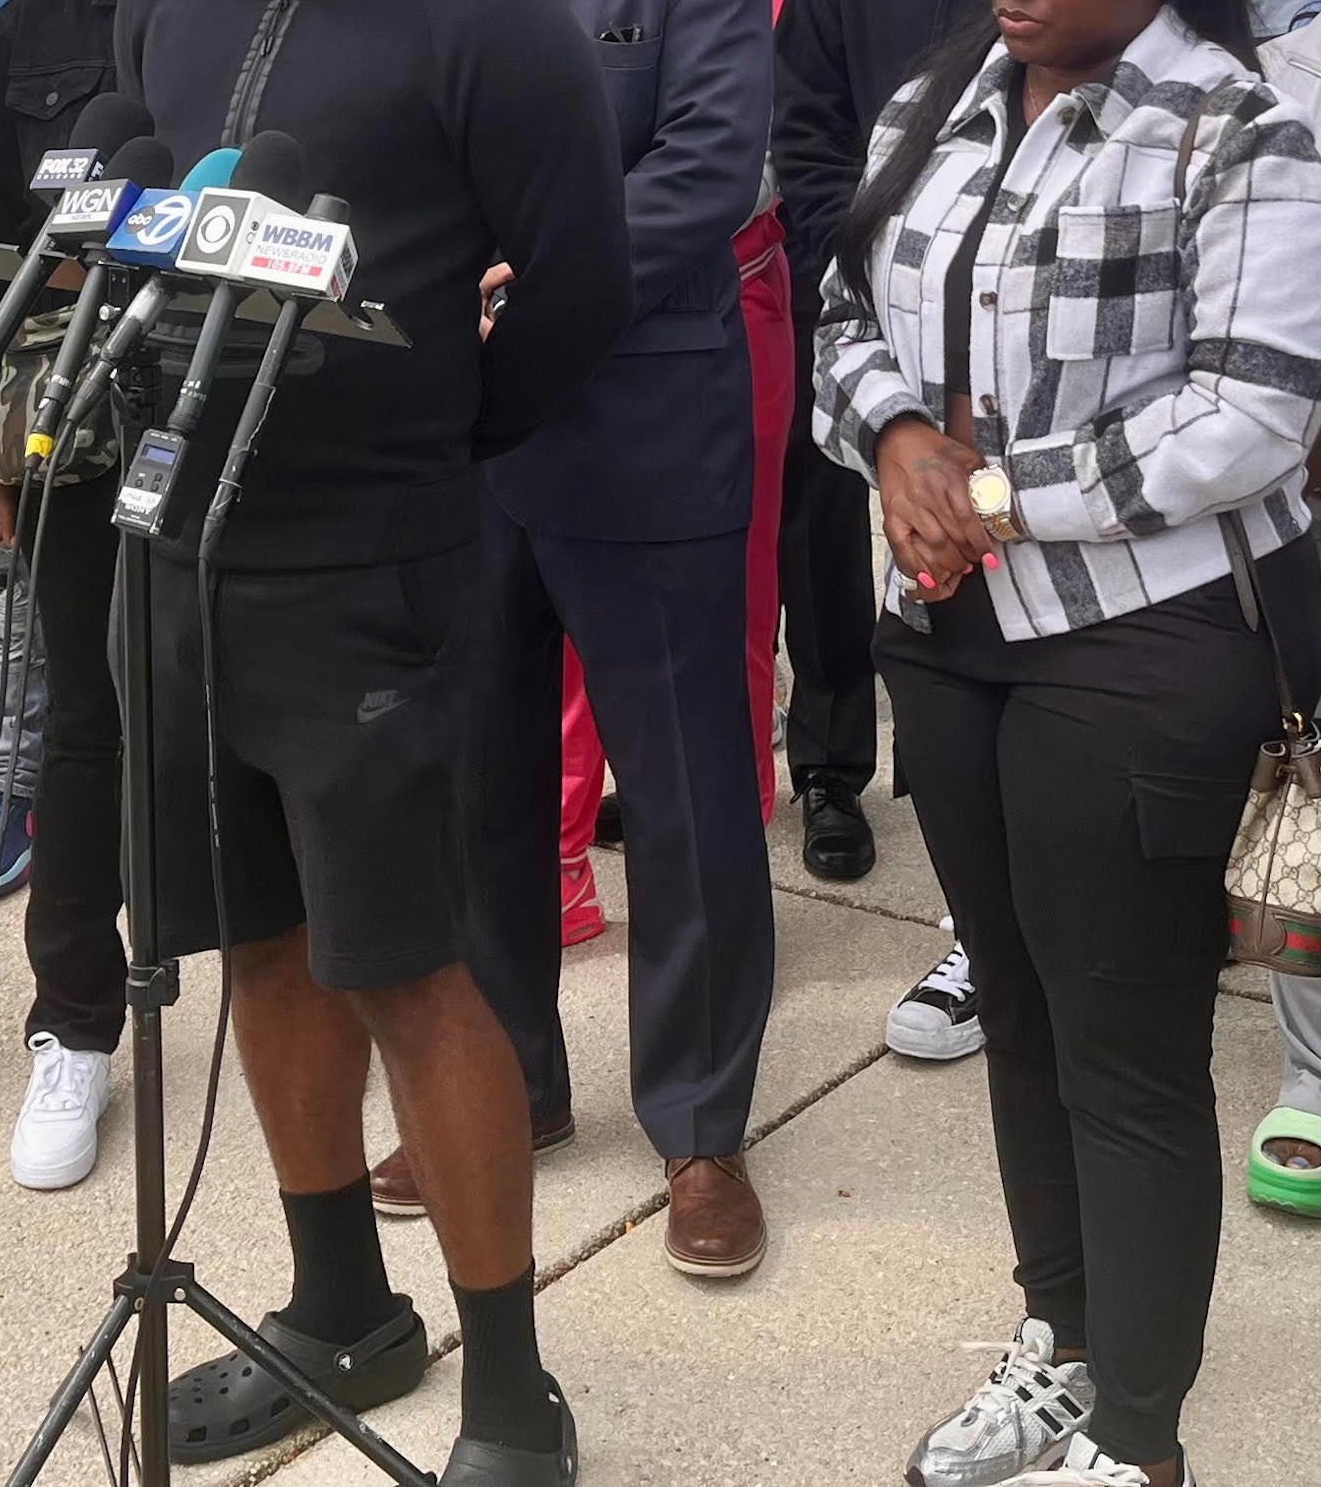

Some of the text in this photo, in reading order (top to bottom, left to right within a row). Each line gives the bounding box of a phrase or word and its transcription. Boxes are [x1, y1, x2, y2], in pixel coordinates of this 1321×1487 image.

[38, 158, 72, 175] FOX
[68, 157, 89, 174] 32
[61, 188, 124, 214] WGN
[127, 213, 153, 225] abc
[262, 224, 334, 252] WBBM
[256, 245, 328, 264] NEWSRADIO
